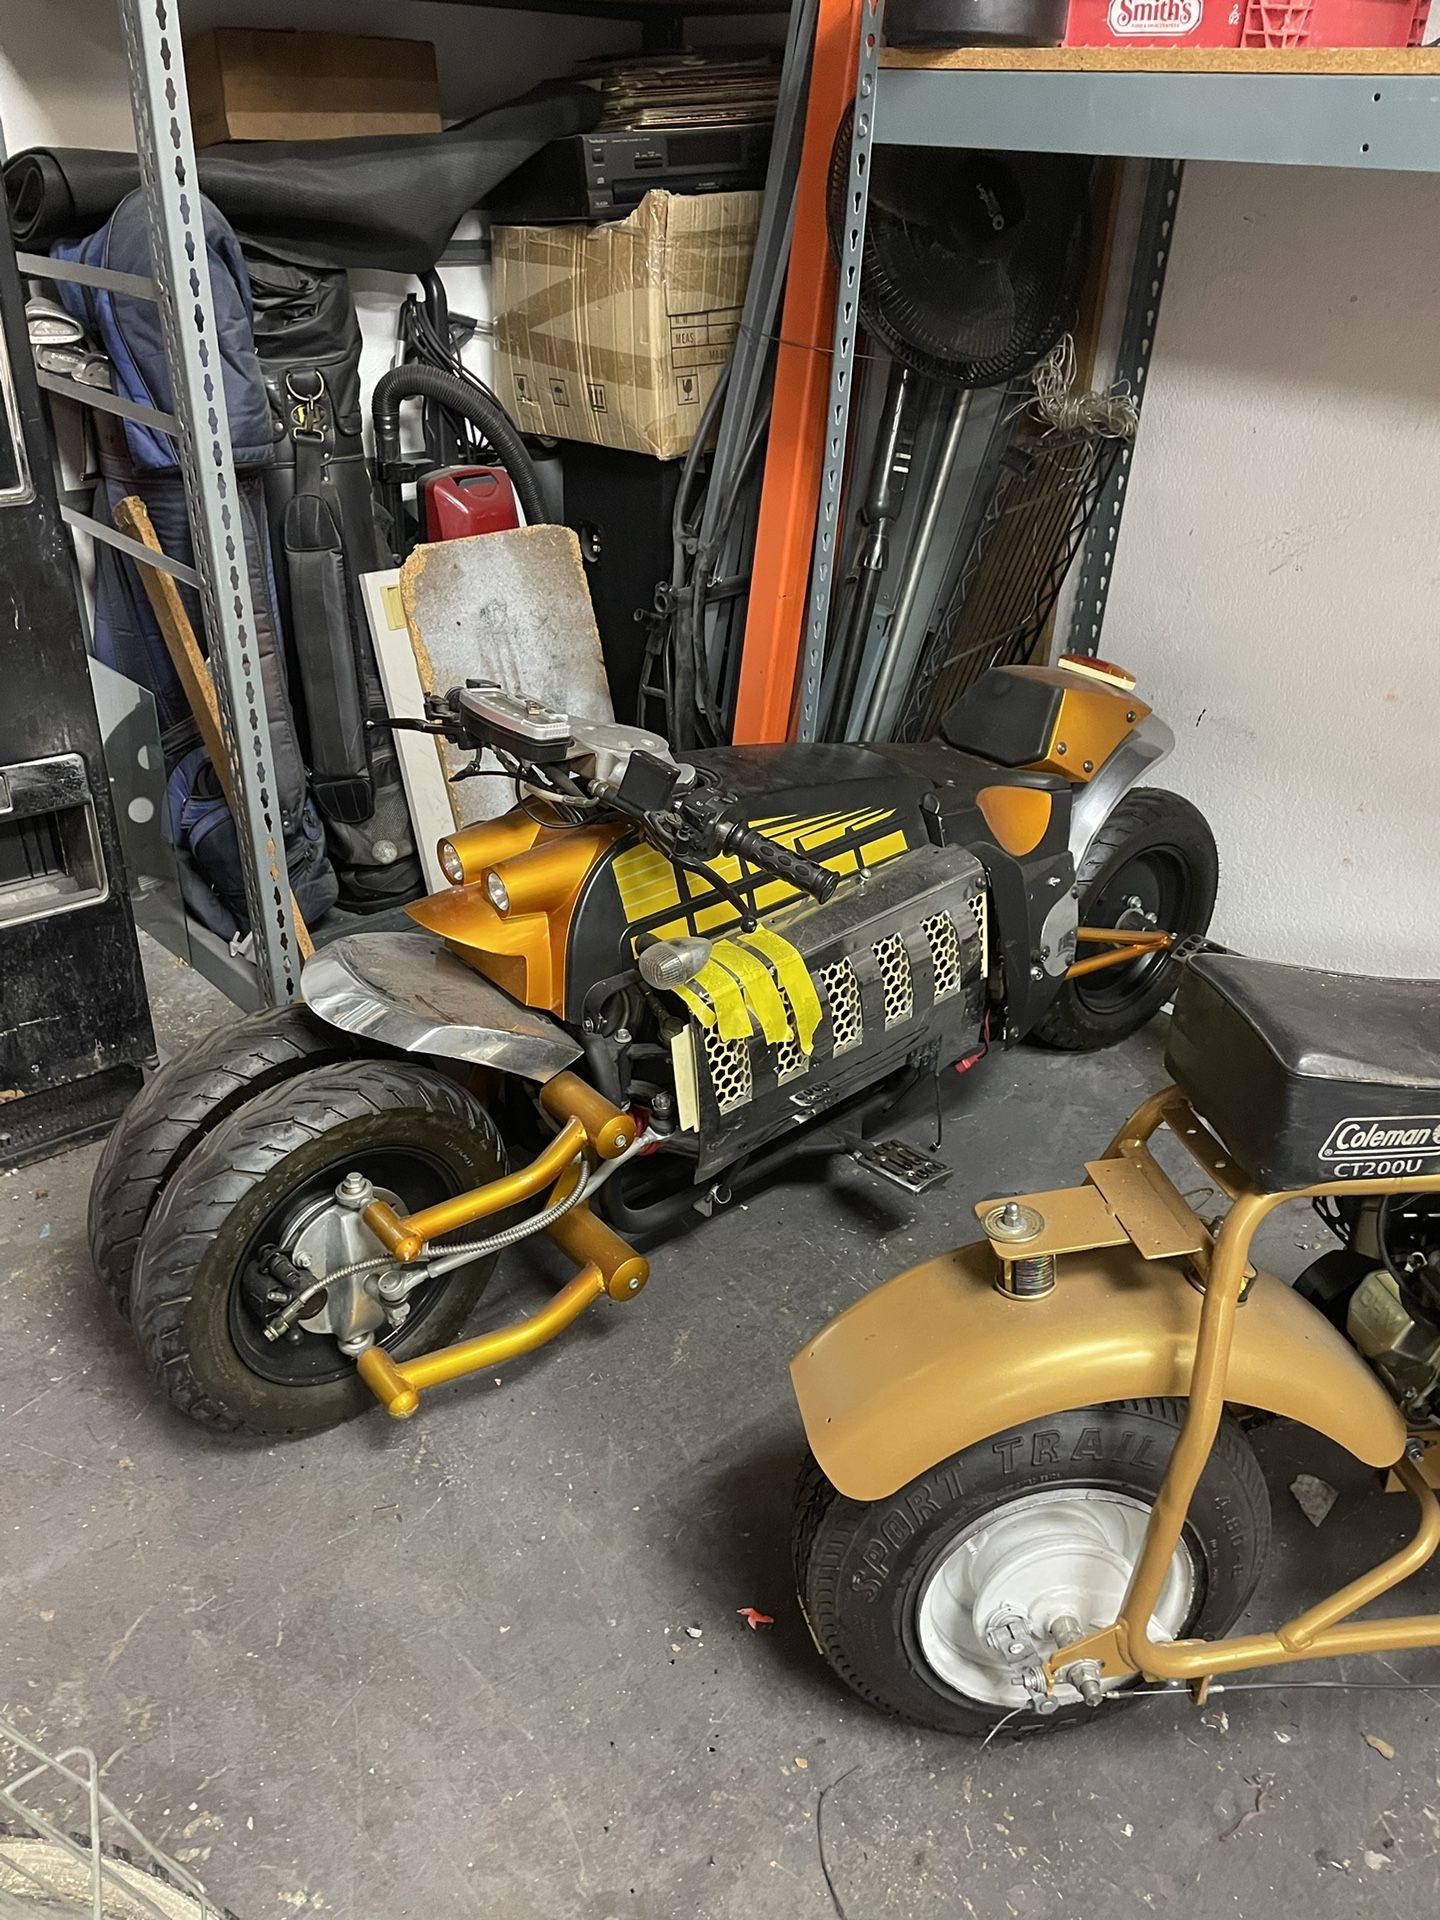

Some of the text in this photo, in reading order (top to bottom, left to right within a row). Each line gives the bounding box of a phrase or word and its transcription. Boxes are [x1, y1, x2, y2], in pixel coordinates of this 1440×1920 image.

[1336, 1123, 1431, 1150] Coleman
[1334, 1159, 1422, 1178] CT200U
[851, 1427, 1159, 1603] SPORT TRAIL
